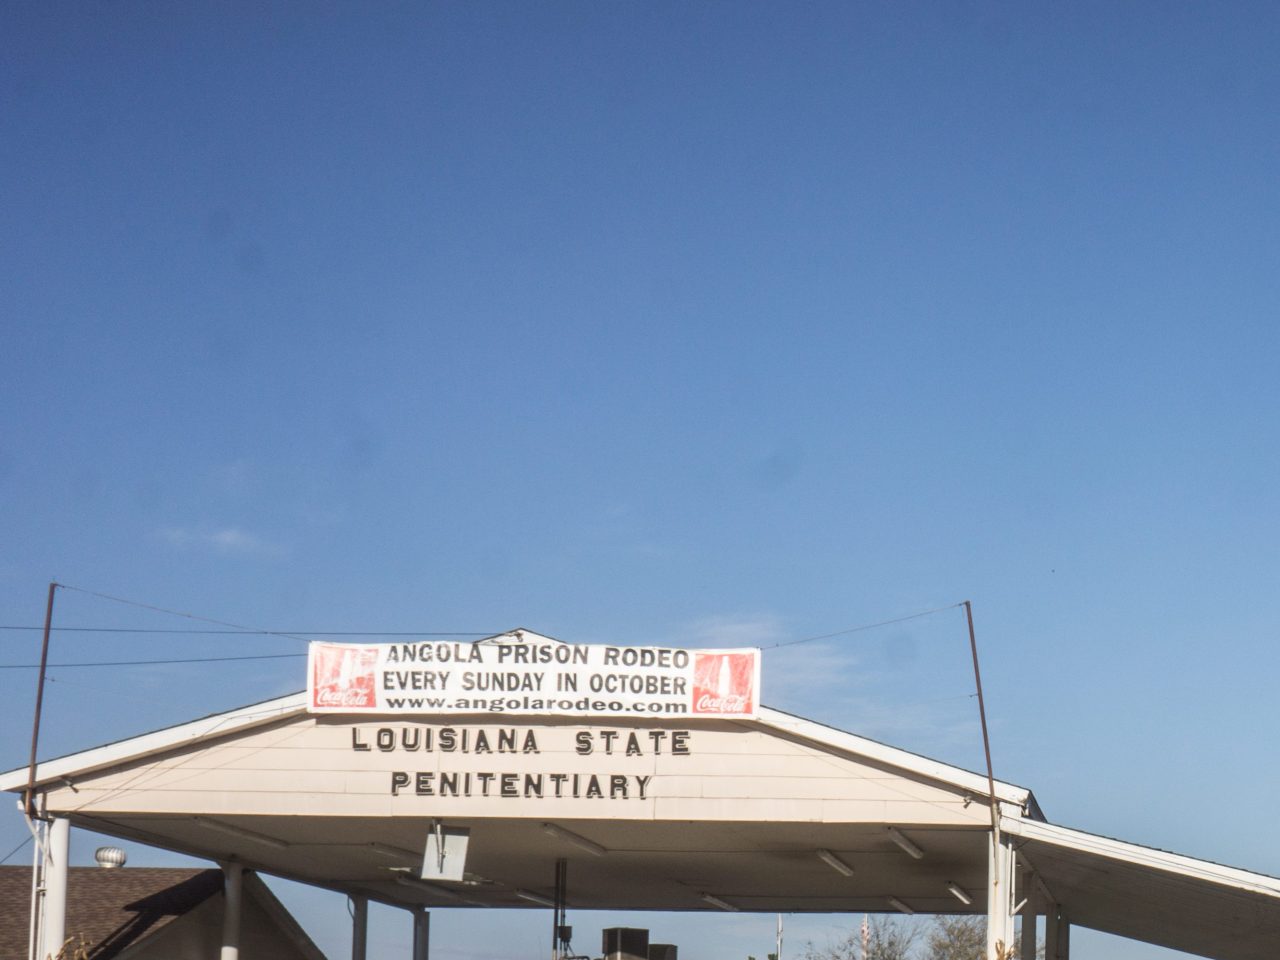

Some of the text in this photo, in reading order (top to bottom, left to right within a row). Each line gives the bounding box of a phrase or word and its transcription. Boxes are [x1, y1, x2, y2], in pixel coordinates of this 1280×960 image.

[386, 644, 690, 669] ANGOLA PRISON RODEO
[383, 671, 687, 695] EVERY SUNDAY IN OCTOBER
[386, 697, 687, 713] www.angolarodeo.com
[352, 727, 691, 757] LOUISIANA STATE
[391, 771, 652, 800] PENITENTIARY
